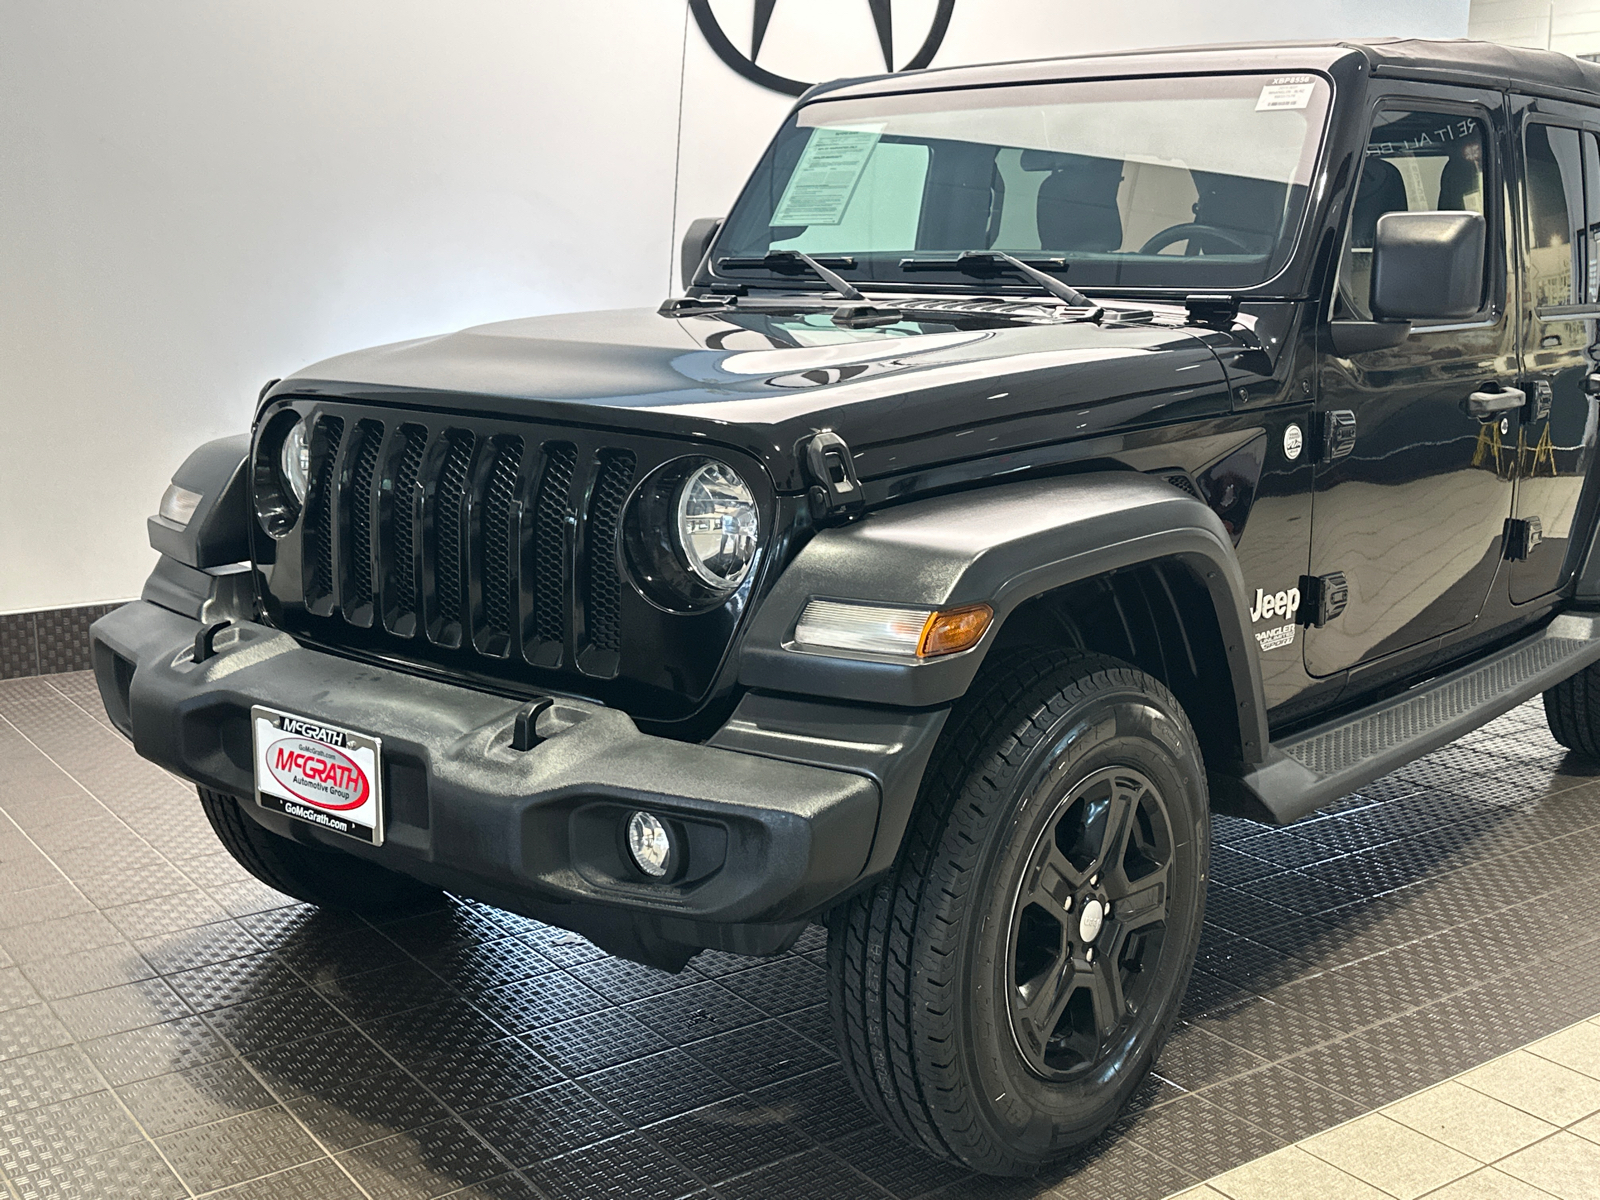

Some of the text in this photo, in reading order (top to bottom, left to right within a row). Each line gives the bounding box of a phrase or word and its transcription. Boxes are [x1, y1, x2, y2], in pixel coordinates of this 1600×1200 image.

[1249, 587, 1300, 623] Jeep
[298, 744, 337, 761] GoMcGrath.com
[292, 775, 350, 801] Automotive Group
[284, 802, 348, 832] GoMcGrath.com
